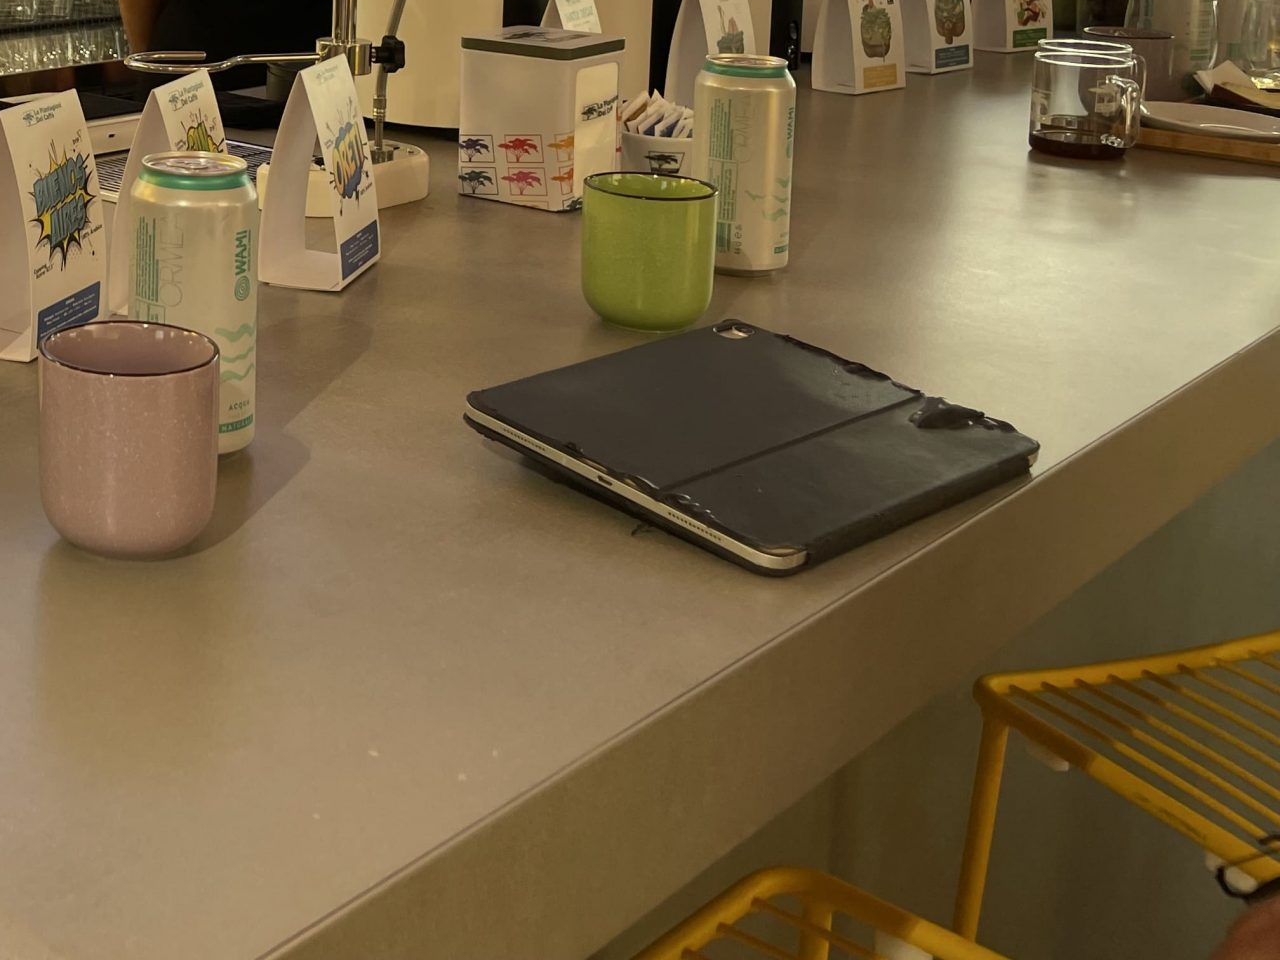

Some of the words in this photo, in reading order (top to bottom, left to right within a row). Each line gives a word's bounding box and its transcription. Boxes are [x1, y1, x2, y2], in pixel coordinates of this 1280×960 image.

[33, 152, 87, 217] BUENOS
[50, 193, 87, 248] AIRES
[235, 230, 248, 276] WAMI
